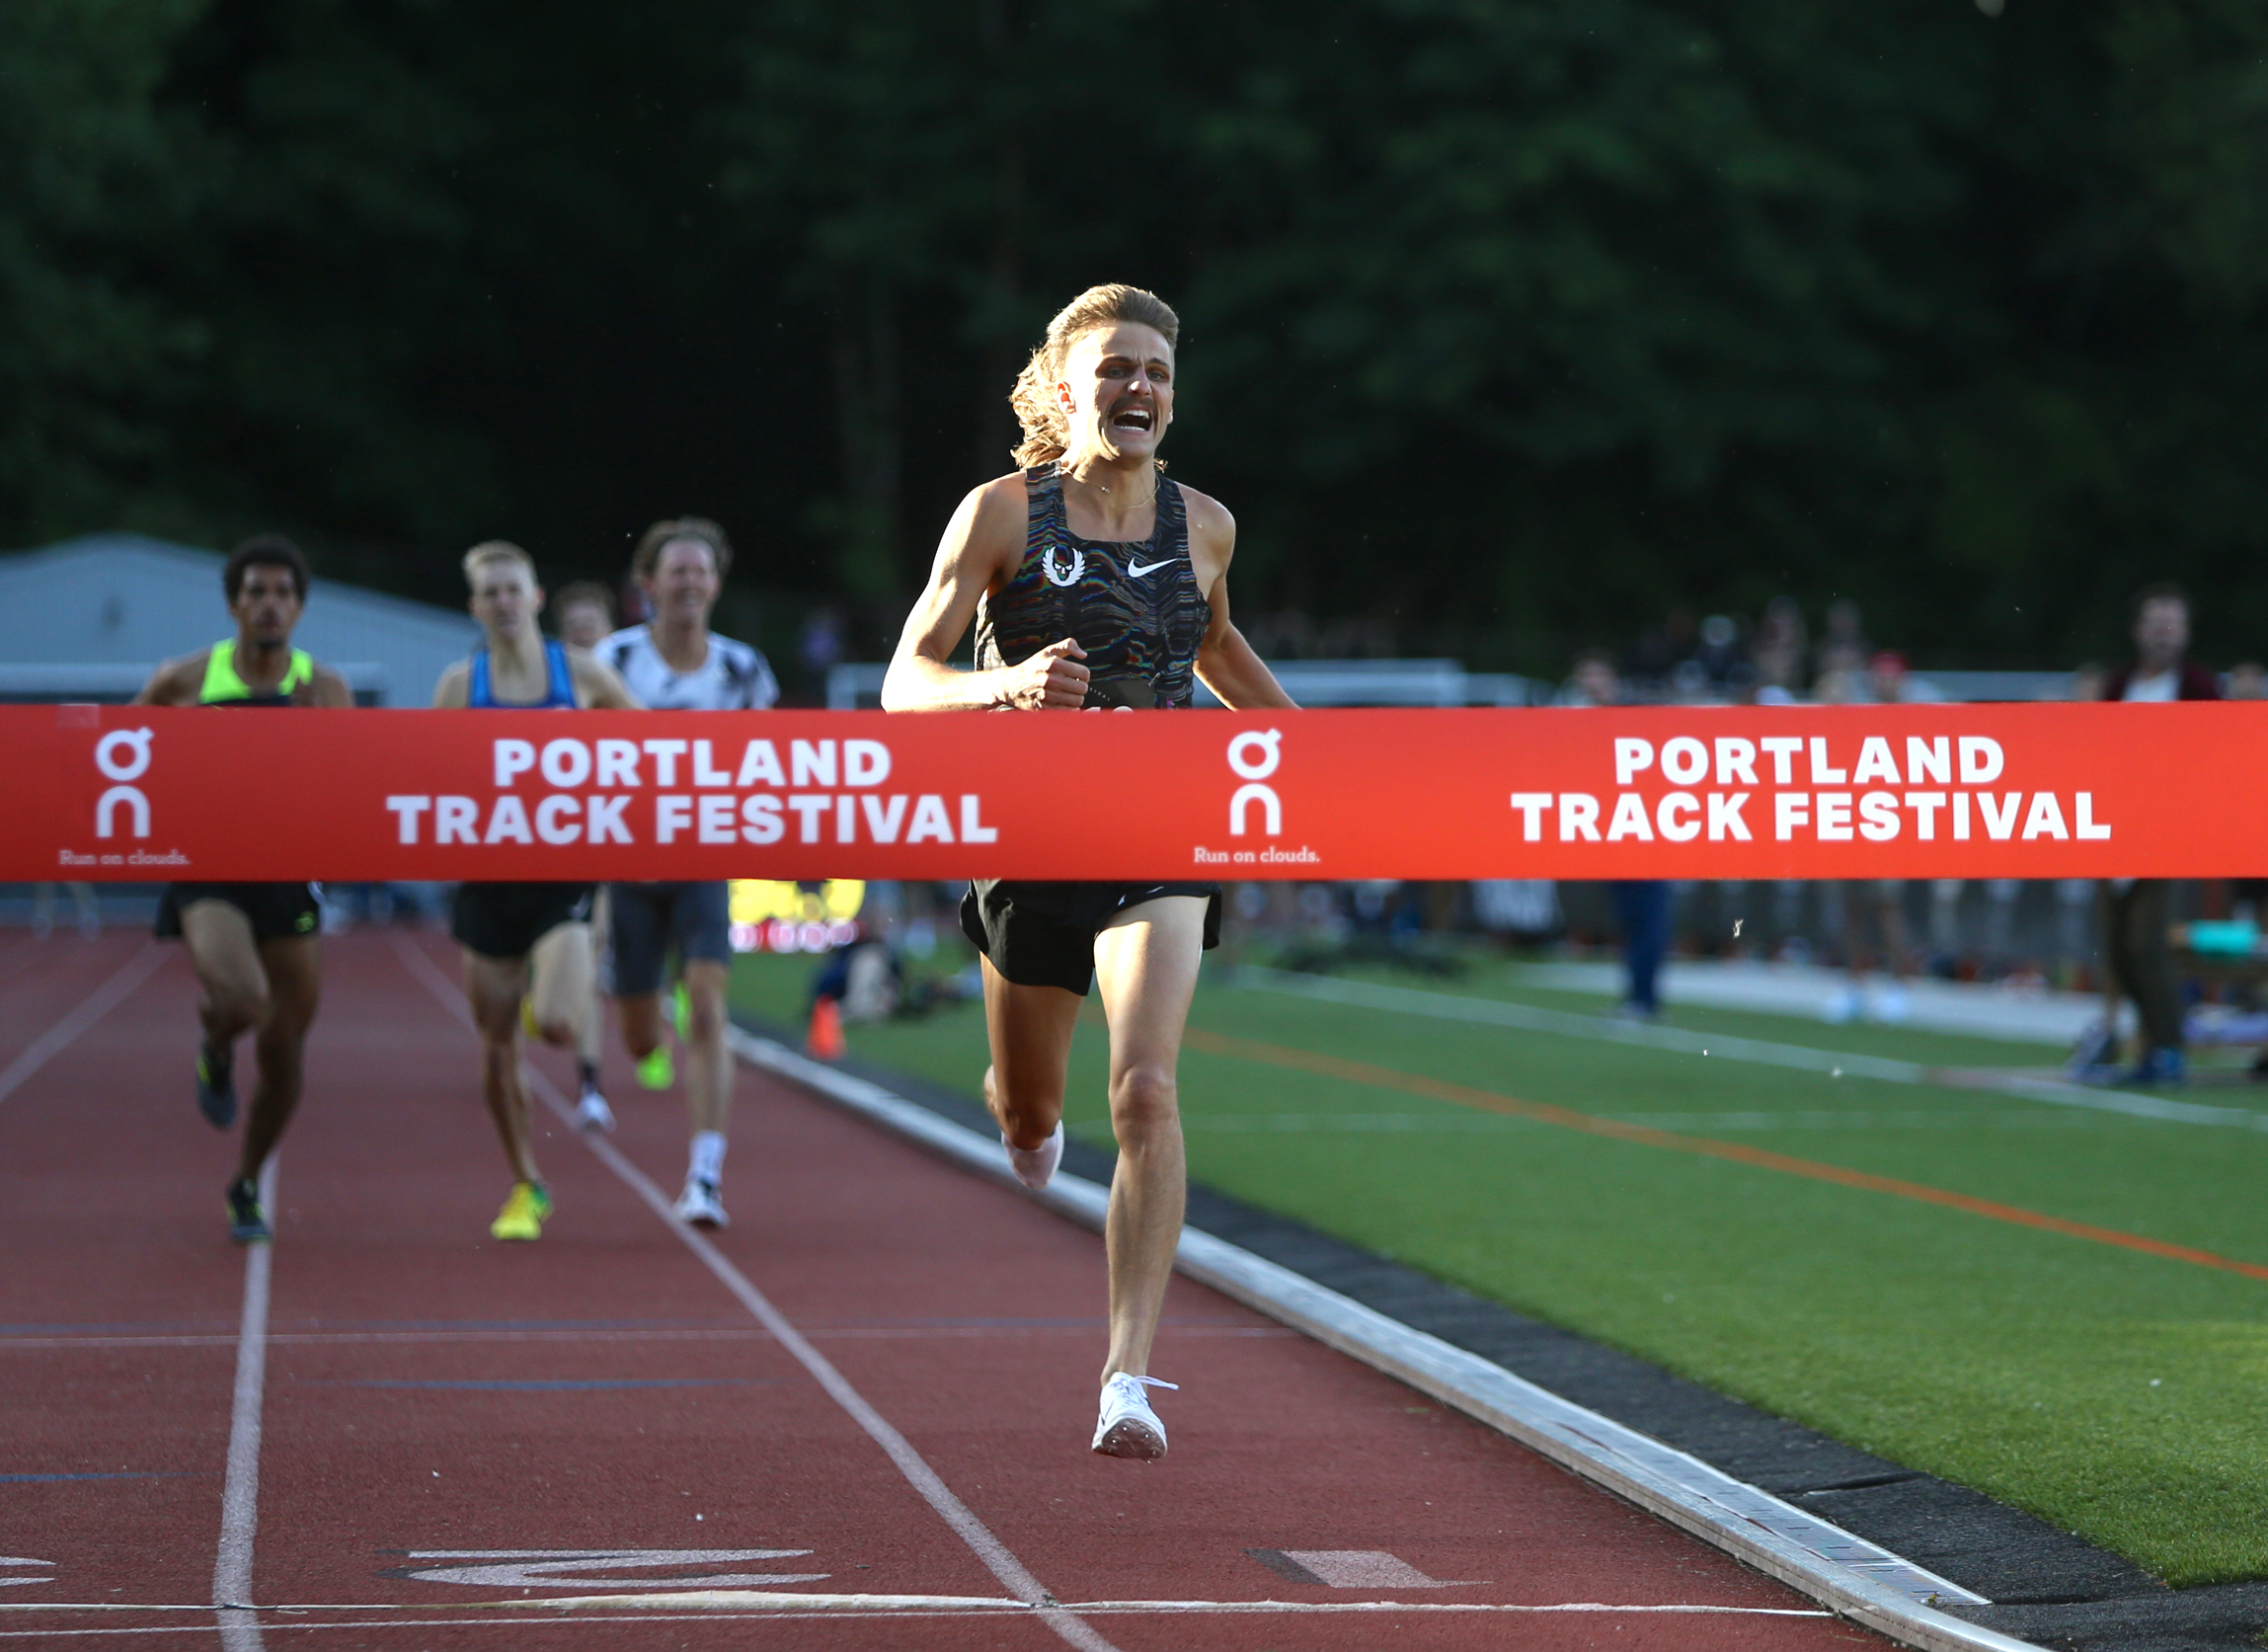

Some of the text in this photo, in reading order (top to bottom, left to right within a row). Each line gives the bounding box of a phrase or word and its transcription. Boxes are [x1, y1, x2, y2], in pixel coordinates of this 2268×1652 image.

[494, 739, 893, 788] PORTLAND
[1613, 736, 2005, 787] PORTLAND
[386, 793, 998, 845] TRACK FESTIVAL
[1510, 790, 2112, 843] TRACK FESTIVAL
[59, 849, 190, 865] Run on clouds.
[1194, 846, 1320, 863] Run on clouds.
